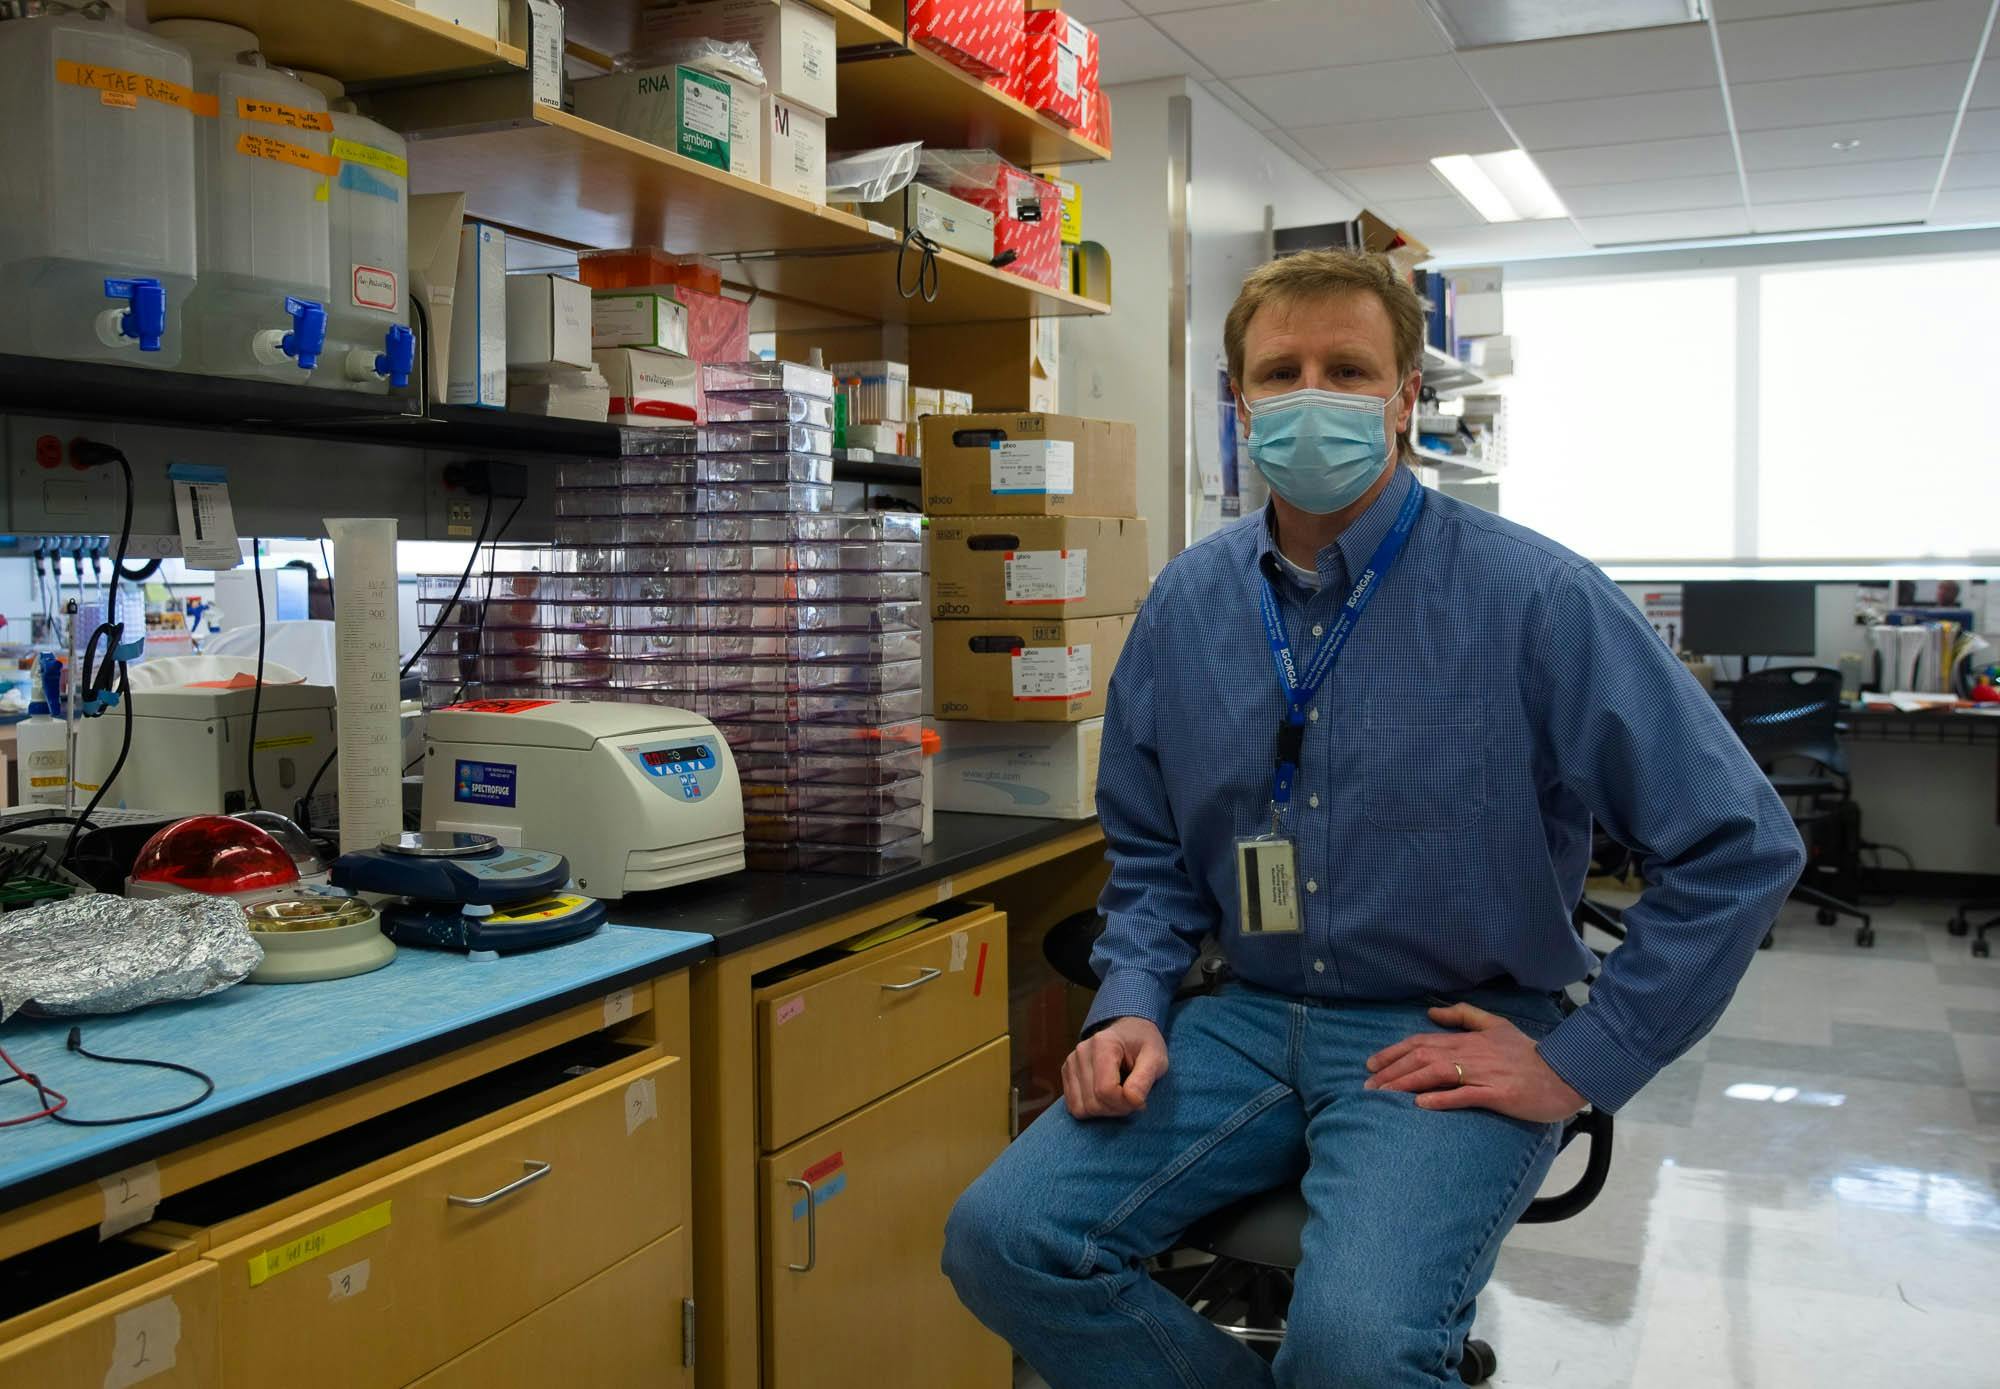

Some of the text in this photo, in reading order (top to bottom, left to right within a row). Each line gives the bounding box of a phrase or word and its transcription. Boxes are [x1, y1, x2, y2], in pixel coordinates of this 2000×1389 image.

[102, 72, 137, 92] TAE
[638, 74, 670, 95] RNA
[774, 104, 790, 137] M
[682, 132, 713, 150] ambion
[927, 494, 953, 506] gibco
[368, 609, 385, 618] 900
[937, 601, 970, 617] gibco
[942, 702, 969, 713] gibco
[472, 783, 510, 795] SPECTROFUGE
[119, 1177, 139, 1204] 2
[132, 1329, 150, 1369] 2
